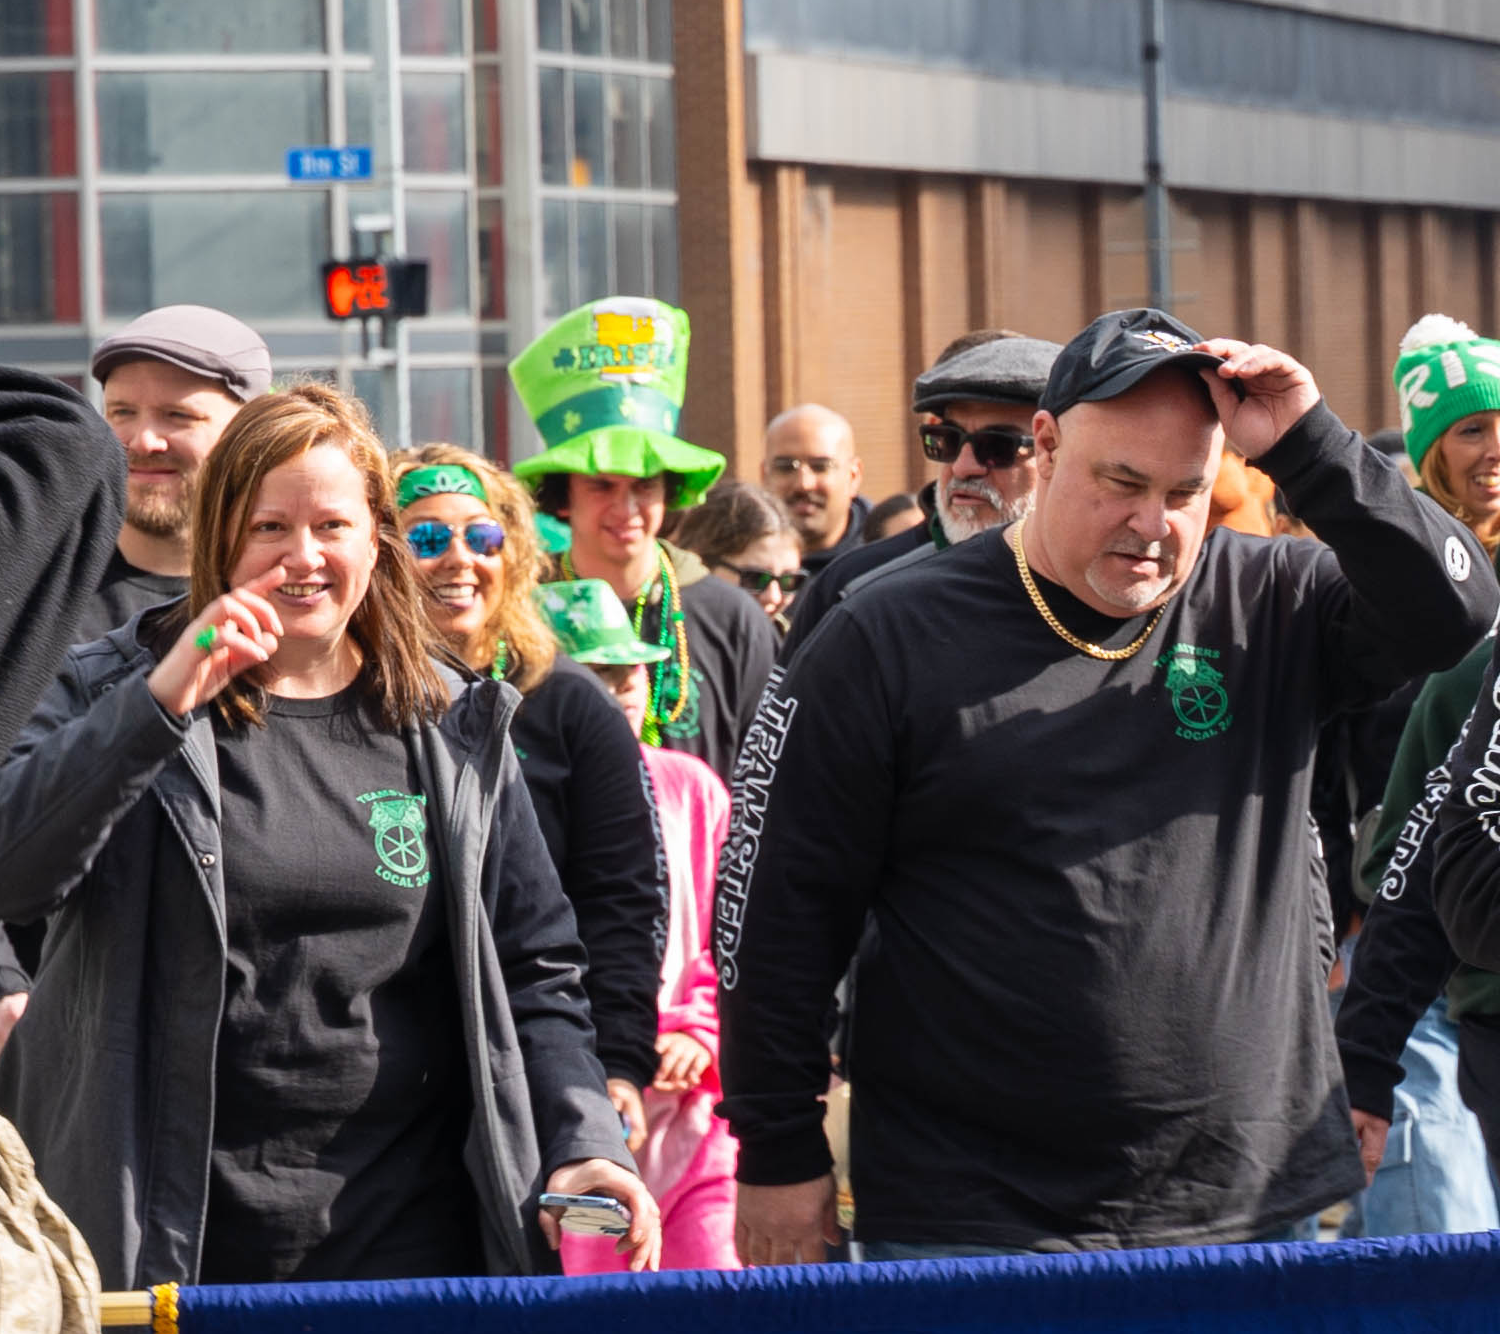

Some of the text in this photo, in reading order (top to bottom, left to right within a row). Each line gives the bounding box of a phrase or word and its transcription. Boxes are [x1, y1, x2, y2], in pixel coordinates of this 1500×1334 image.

[340, 152, 361, 175] St
[579, 343, 675, 370] IRISH
[1175, 726, 1218, 741] LOCAL
[374, 865, 415, 888] LOCAL
